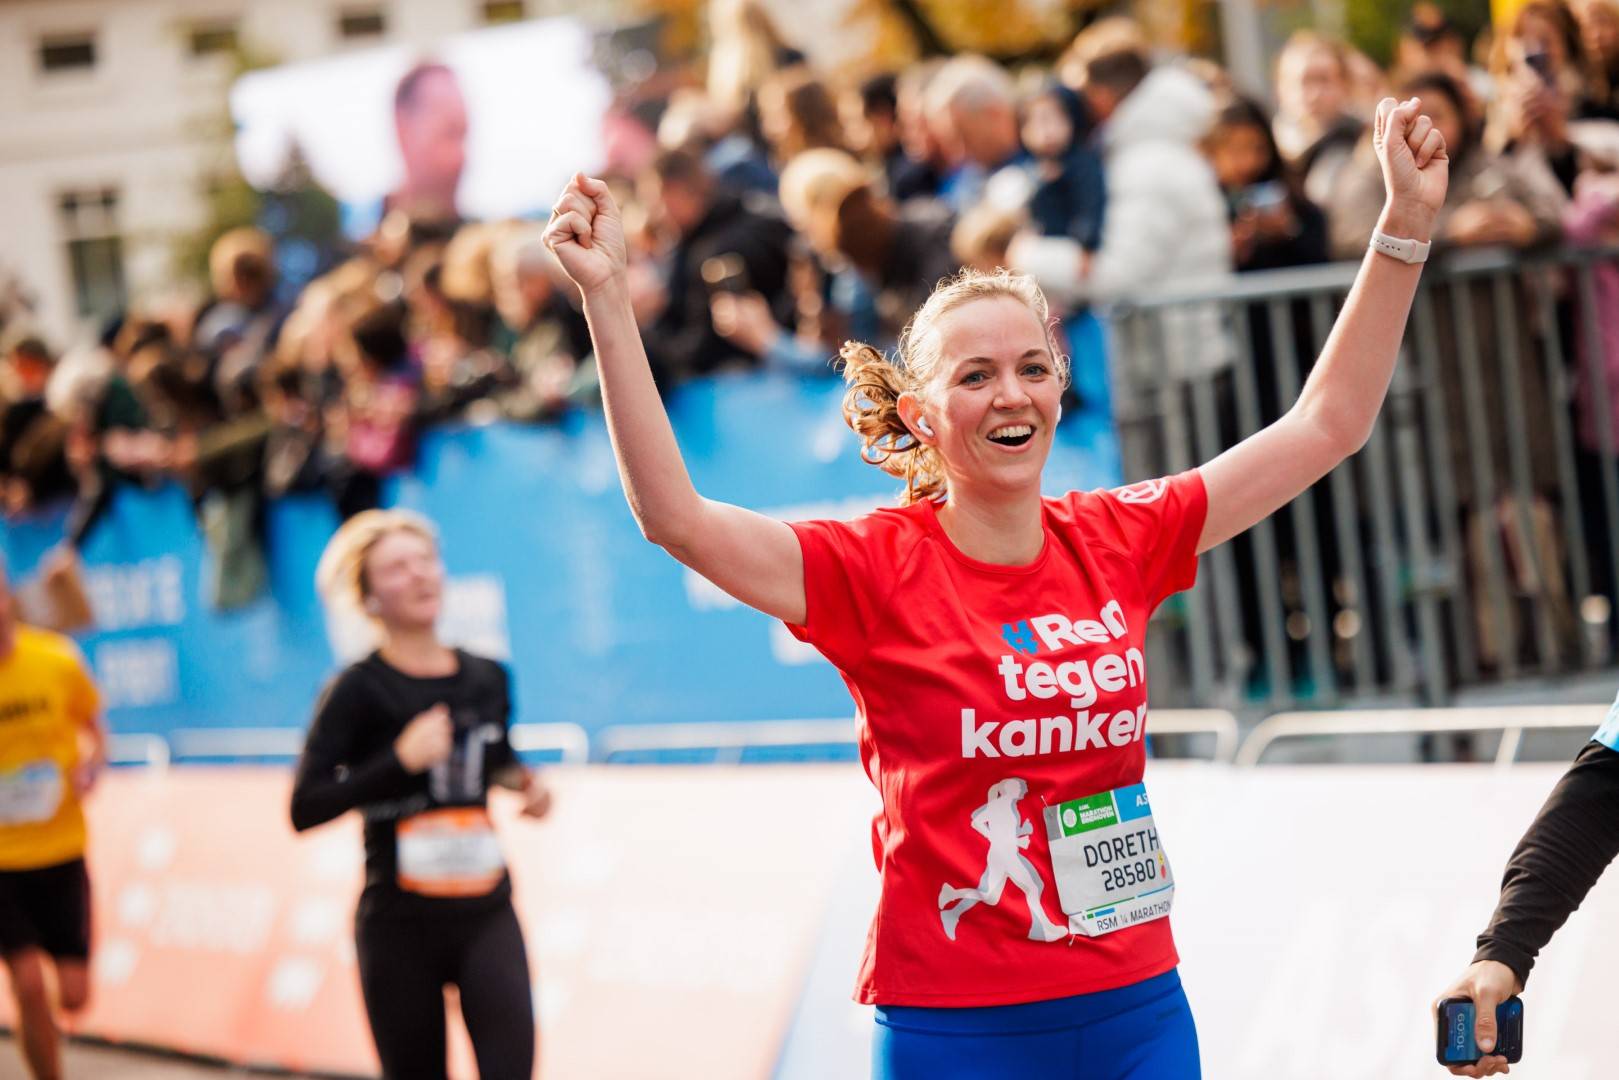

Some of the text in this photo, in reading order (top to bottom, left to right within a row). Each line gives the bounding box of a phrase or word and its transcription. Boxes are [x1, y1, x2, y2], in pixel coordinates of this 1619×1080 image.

[1002, 600, 1128, 655] #Ren
[998, 648, 1144, 709] tegen
[961, 703, 1147, 758] kanker
[1084, 828, 1159, 868] DORETH
[1102, 859, 1155, 892] 28580
[1097, 916, 1118, 931] RSM
